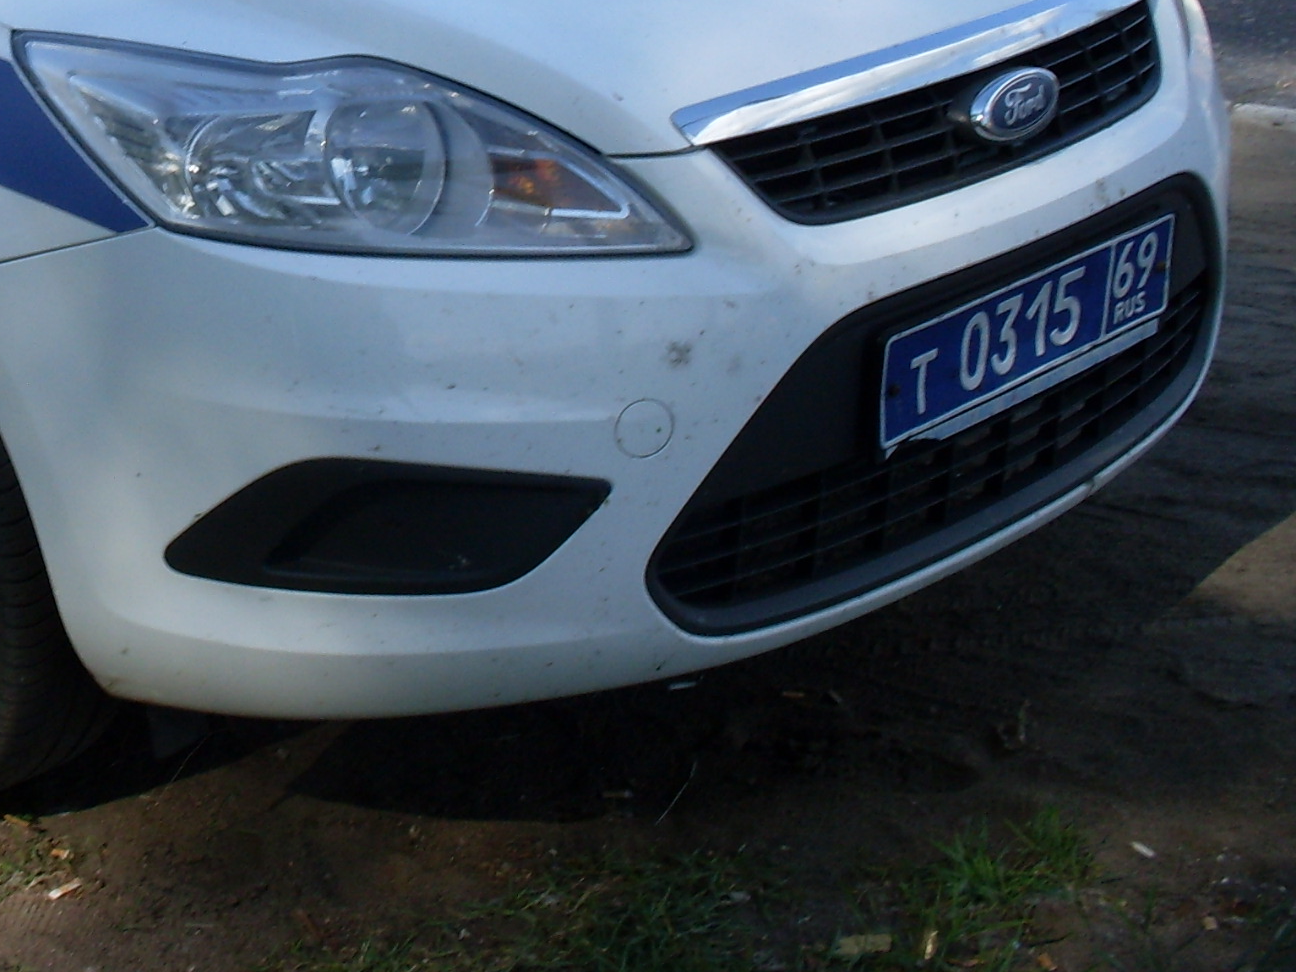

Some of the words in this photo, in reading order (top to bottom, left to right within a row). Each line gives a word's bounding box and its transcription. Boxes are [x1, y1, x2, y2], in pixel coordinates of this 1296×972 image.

[1004, 82, 1045, 126] Ford
[959, 265, 1087, 392] 0315
[1112, 231, 1159, 300] 69
[1112, 290, 1147, 326] RUS
